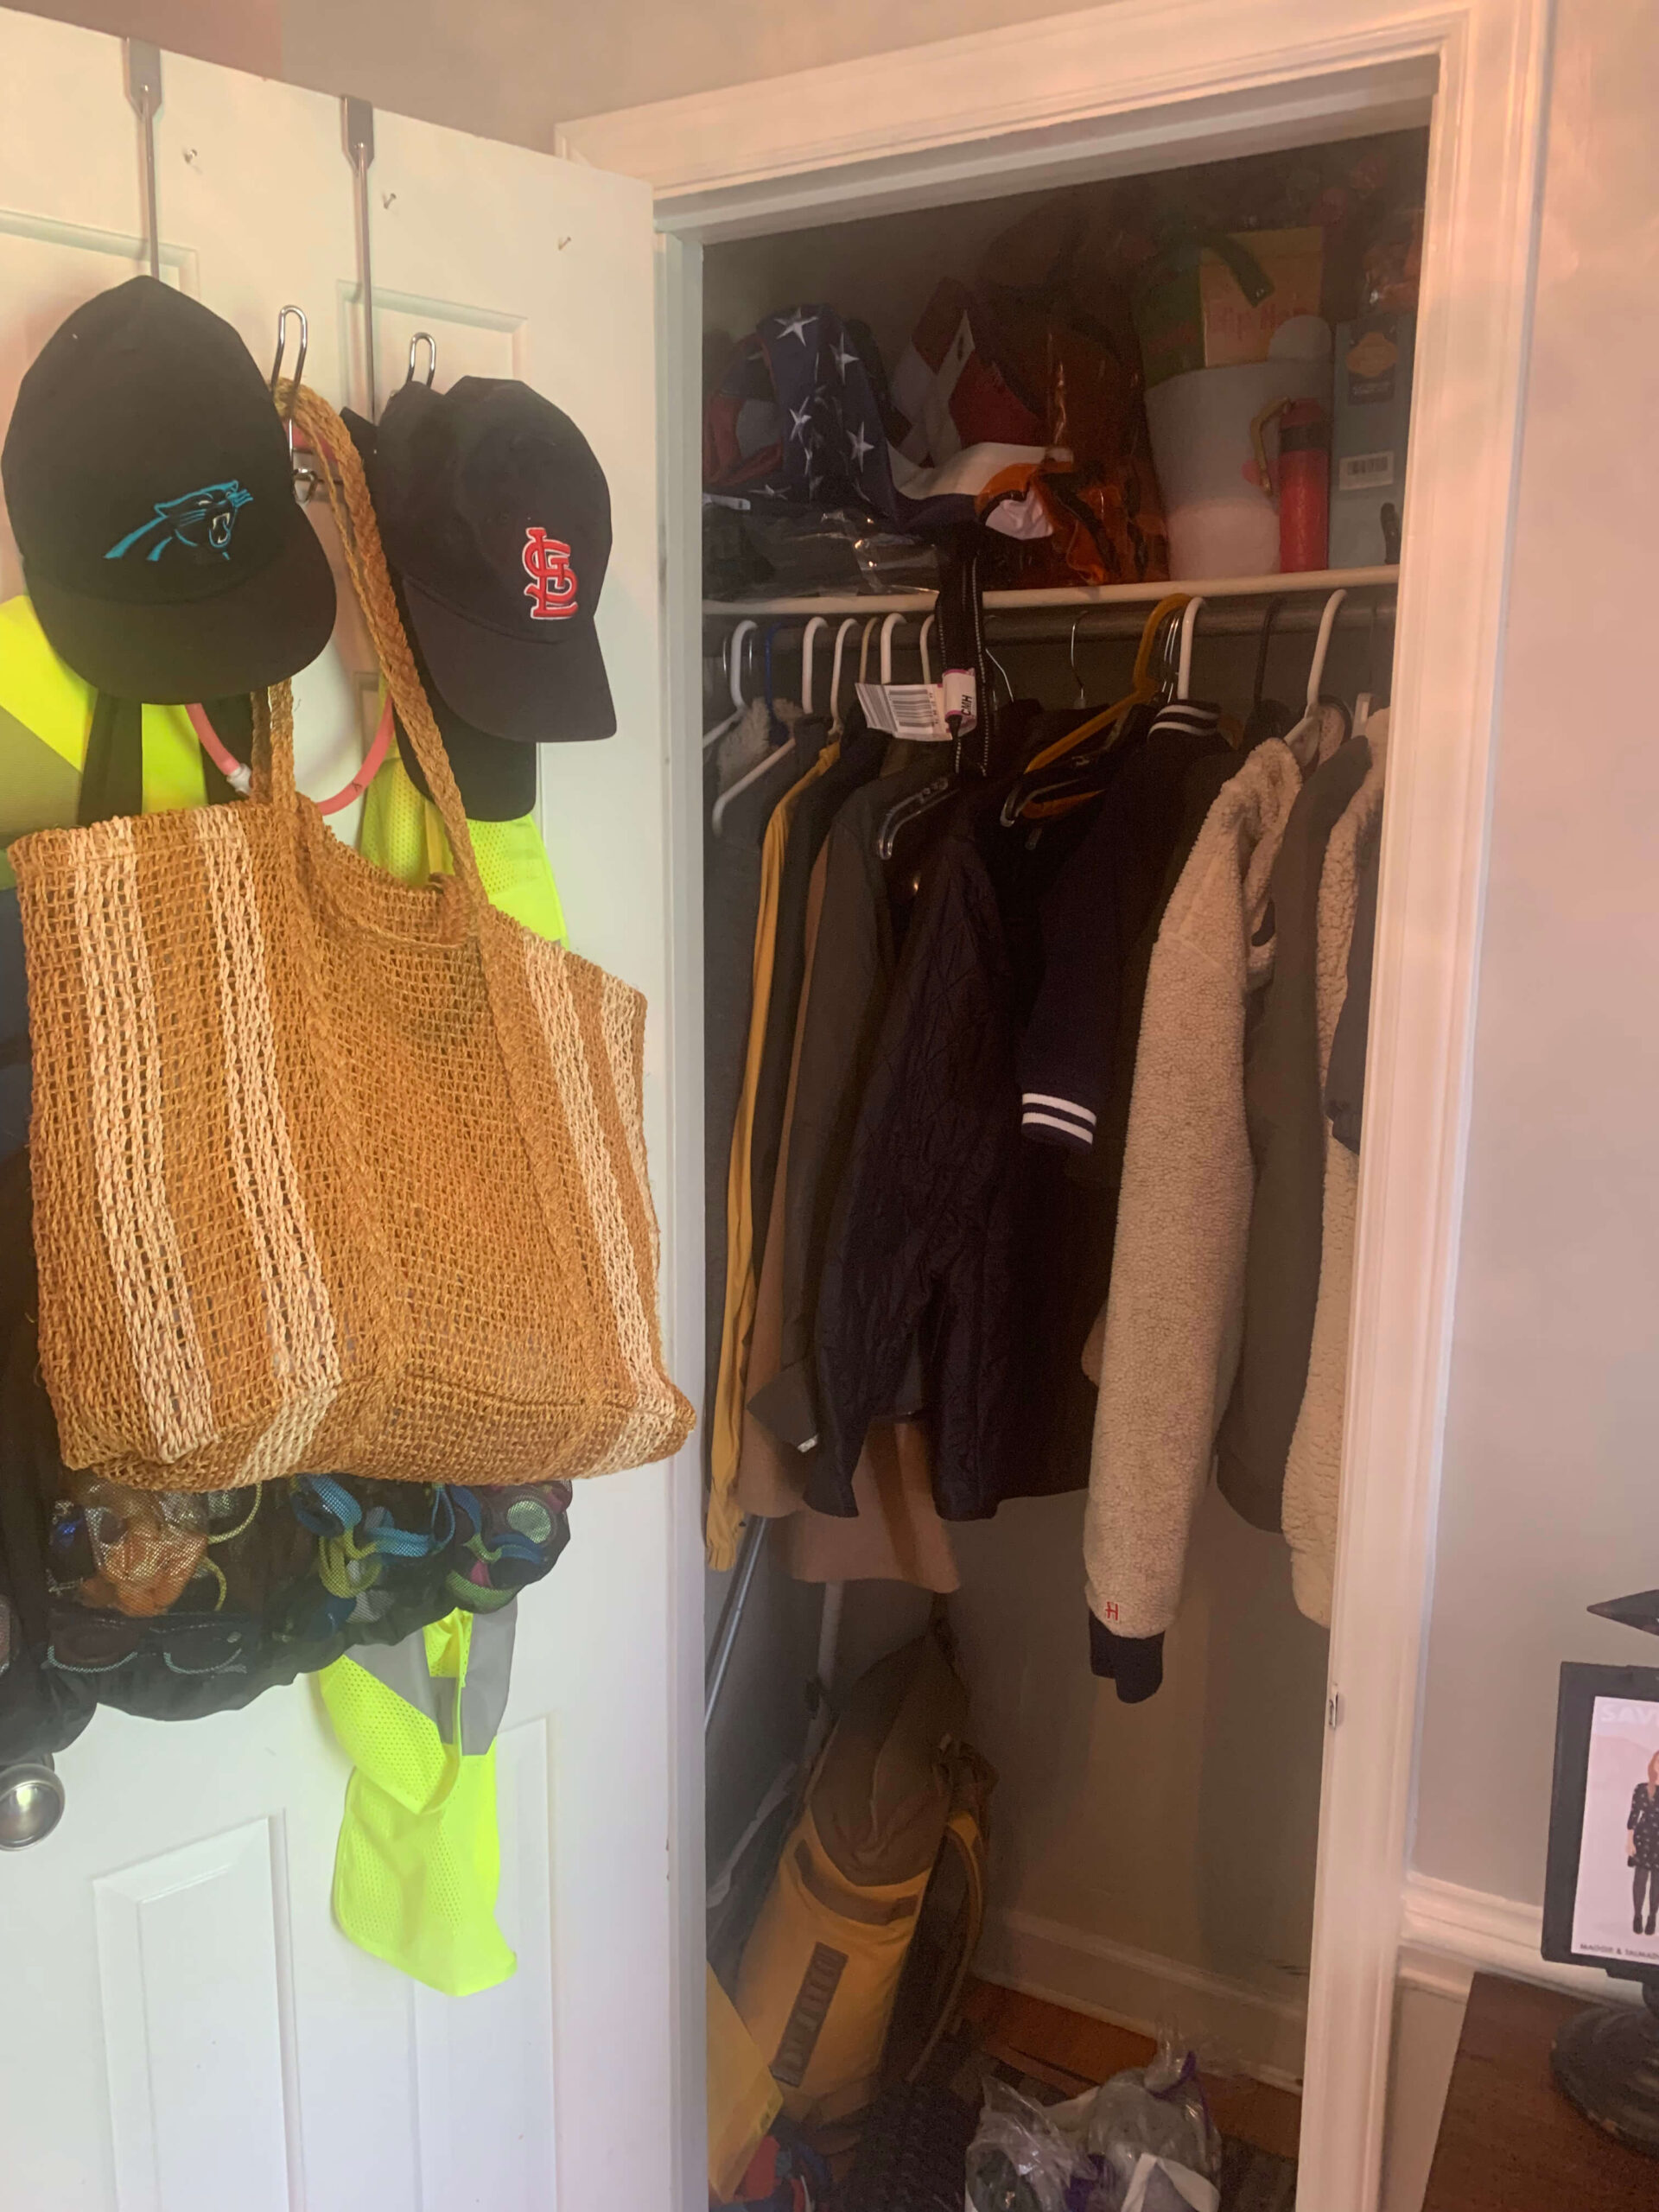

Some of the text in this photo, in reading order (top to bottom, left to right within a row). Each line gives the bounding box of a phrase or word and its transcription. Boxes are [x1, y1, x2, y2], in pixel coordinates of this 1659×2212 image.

[961, 694, 973, 716] CMH
[1104, 1601, 1118, 1621] H
[1600, 1703, 1659, 1726] SAV
